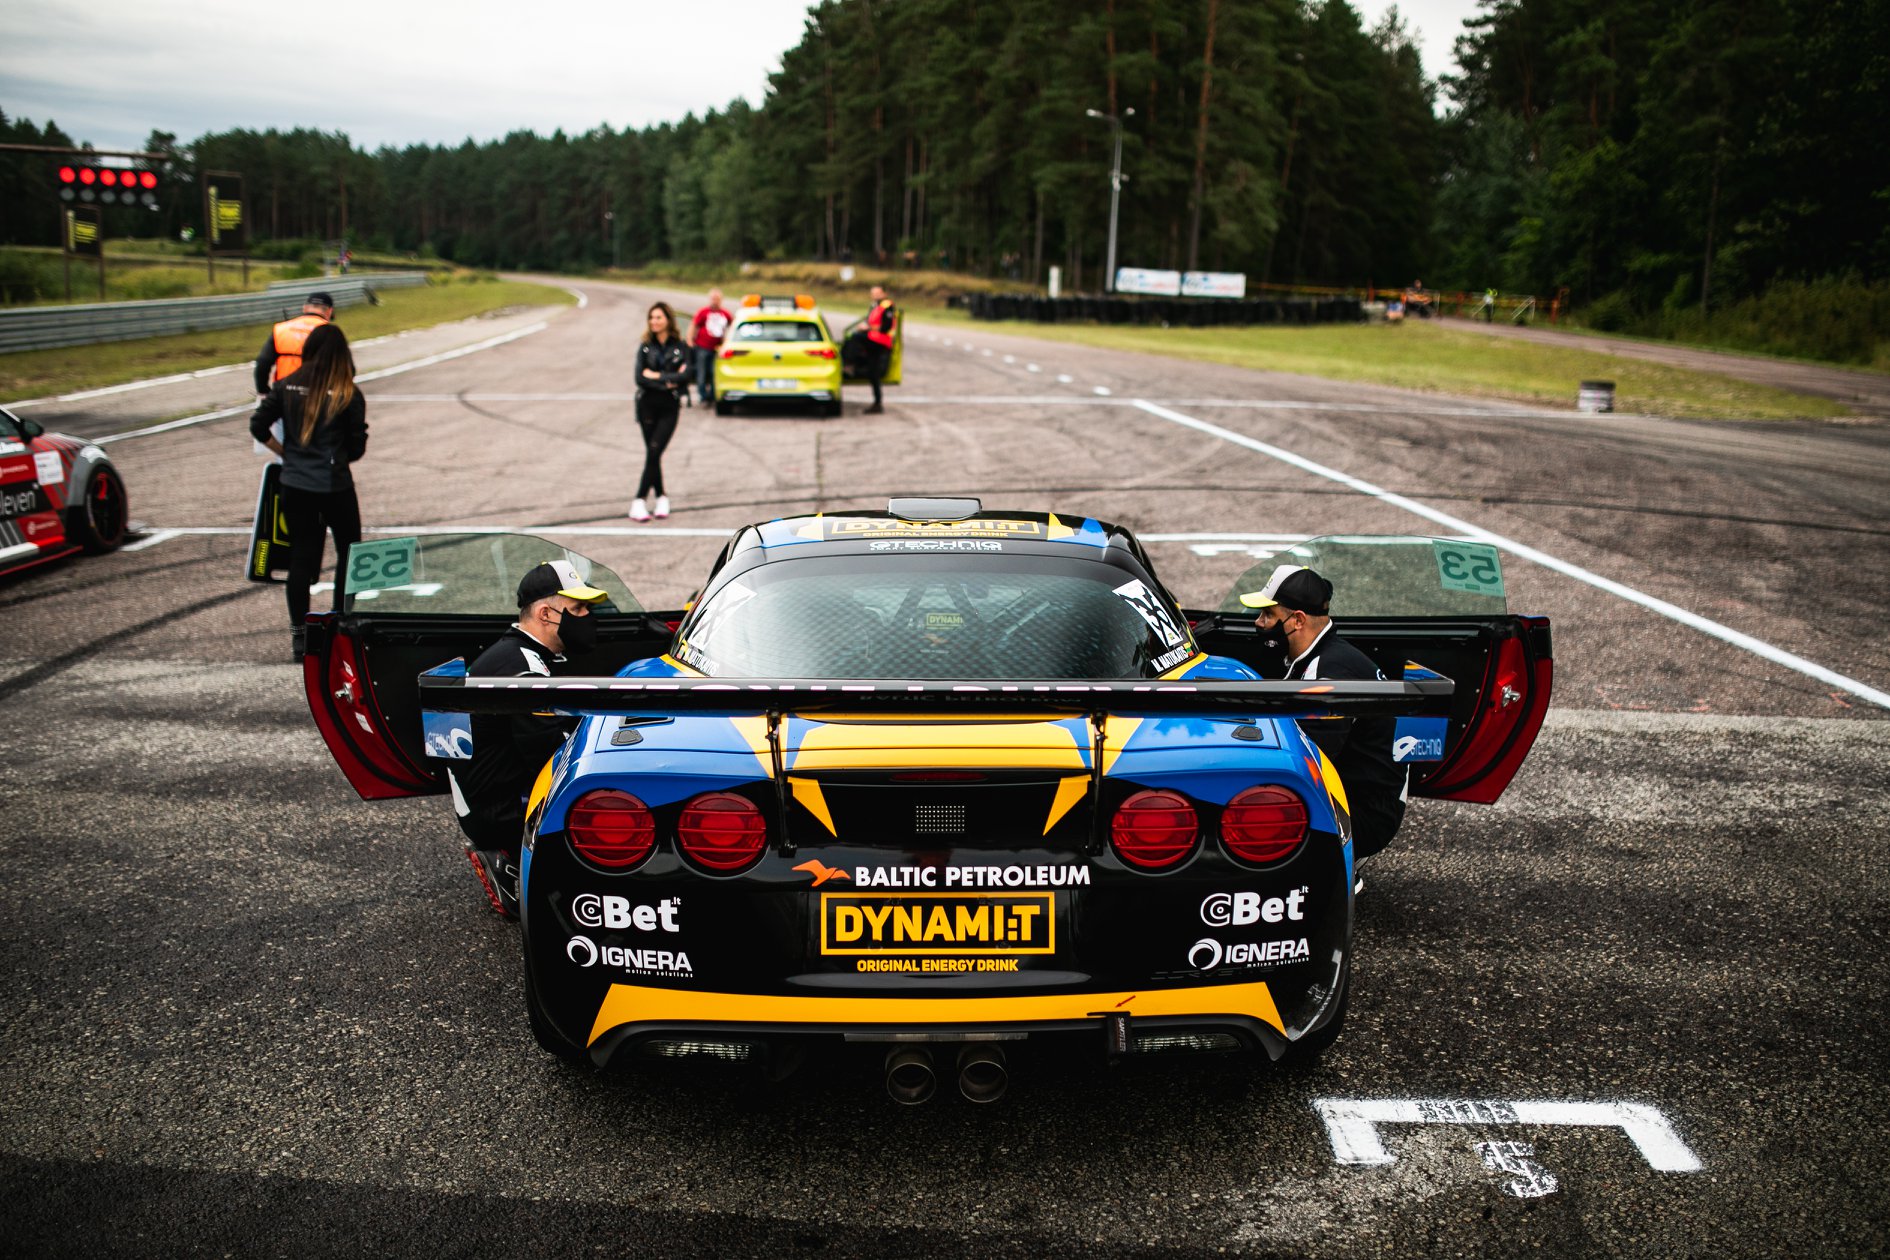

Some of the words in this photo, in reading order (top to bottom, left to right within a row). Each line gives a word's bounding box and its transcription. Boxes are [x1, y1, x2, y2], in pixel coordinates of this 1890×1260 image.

[855, 866, 936, 887] BALTIC
[945, 865, 1090, 887] PETROLEUM
[835, 904, 1041, 942] DYNAMI:T
[601, 946, 693, 971] IGNERA
[1225, 938, 1310, 964] IGNERA
[1276, 956, 1310, 966] solutions
[656, 970, 694, 978] solutions
[857, 958, 920, 972] ORIGINAL
[921, 958, 976, 972] ENERGY
[977, 958, 1019, 972] DRINK
